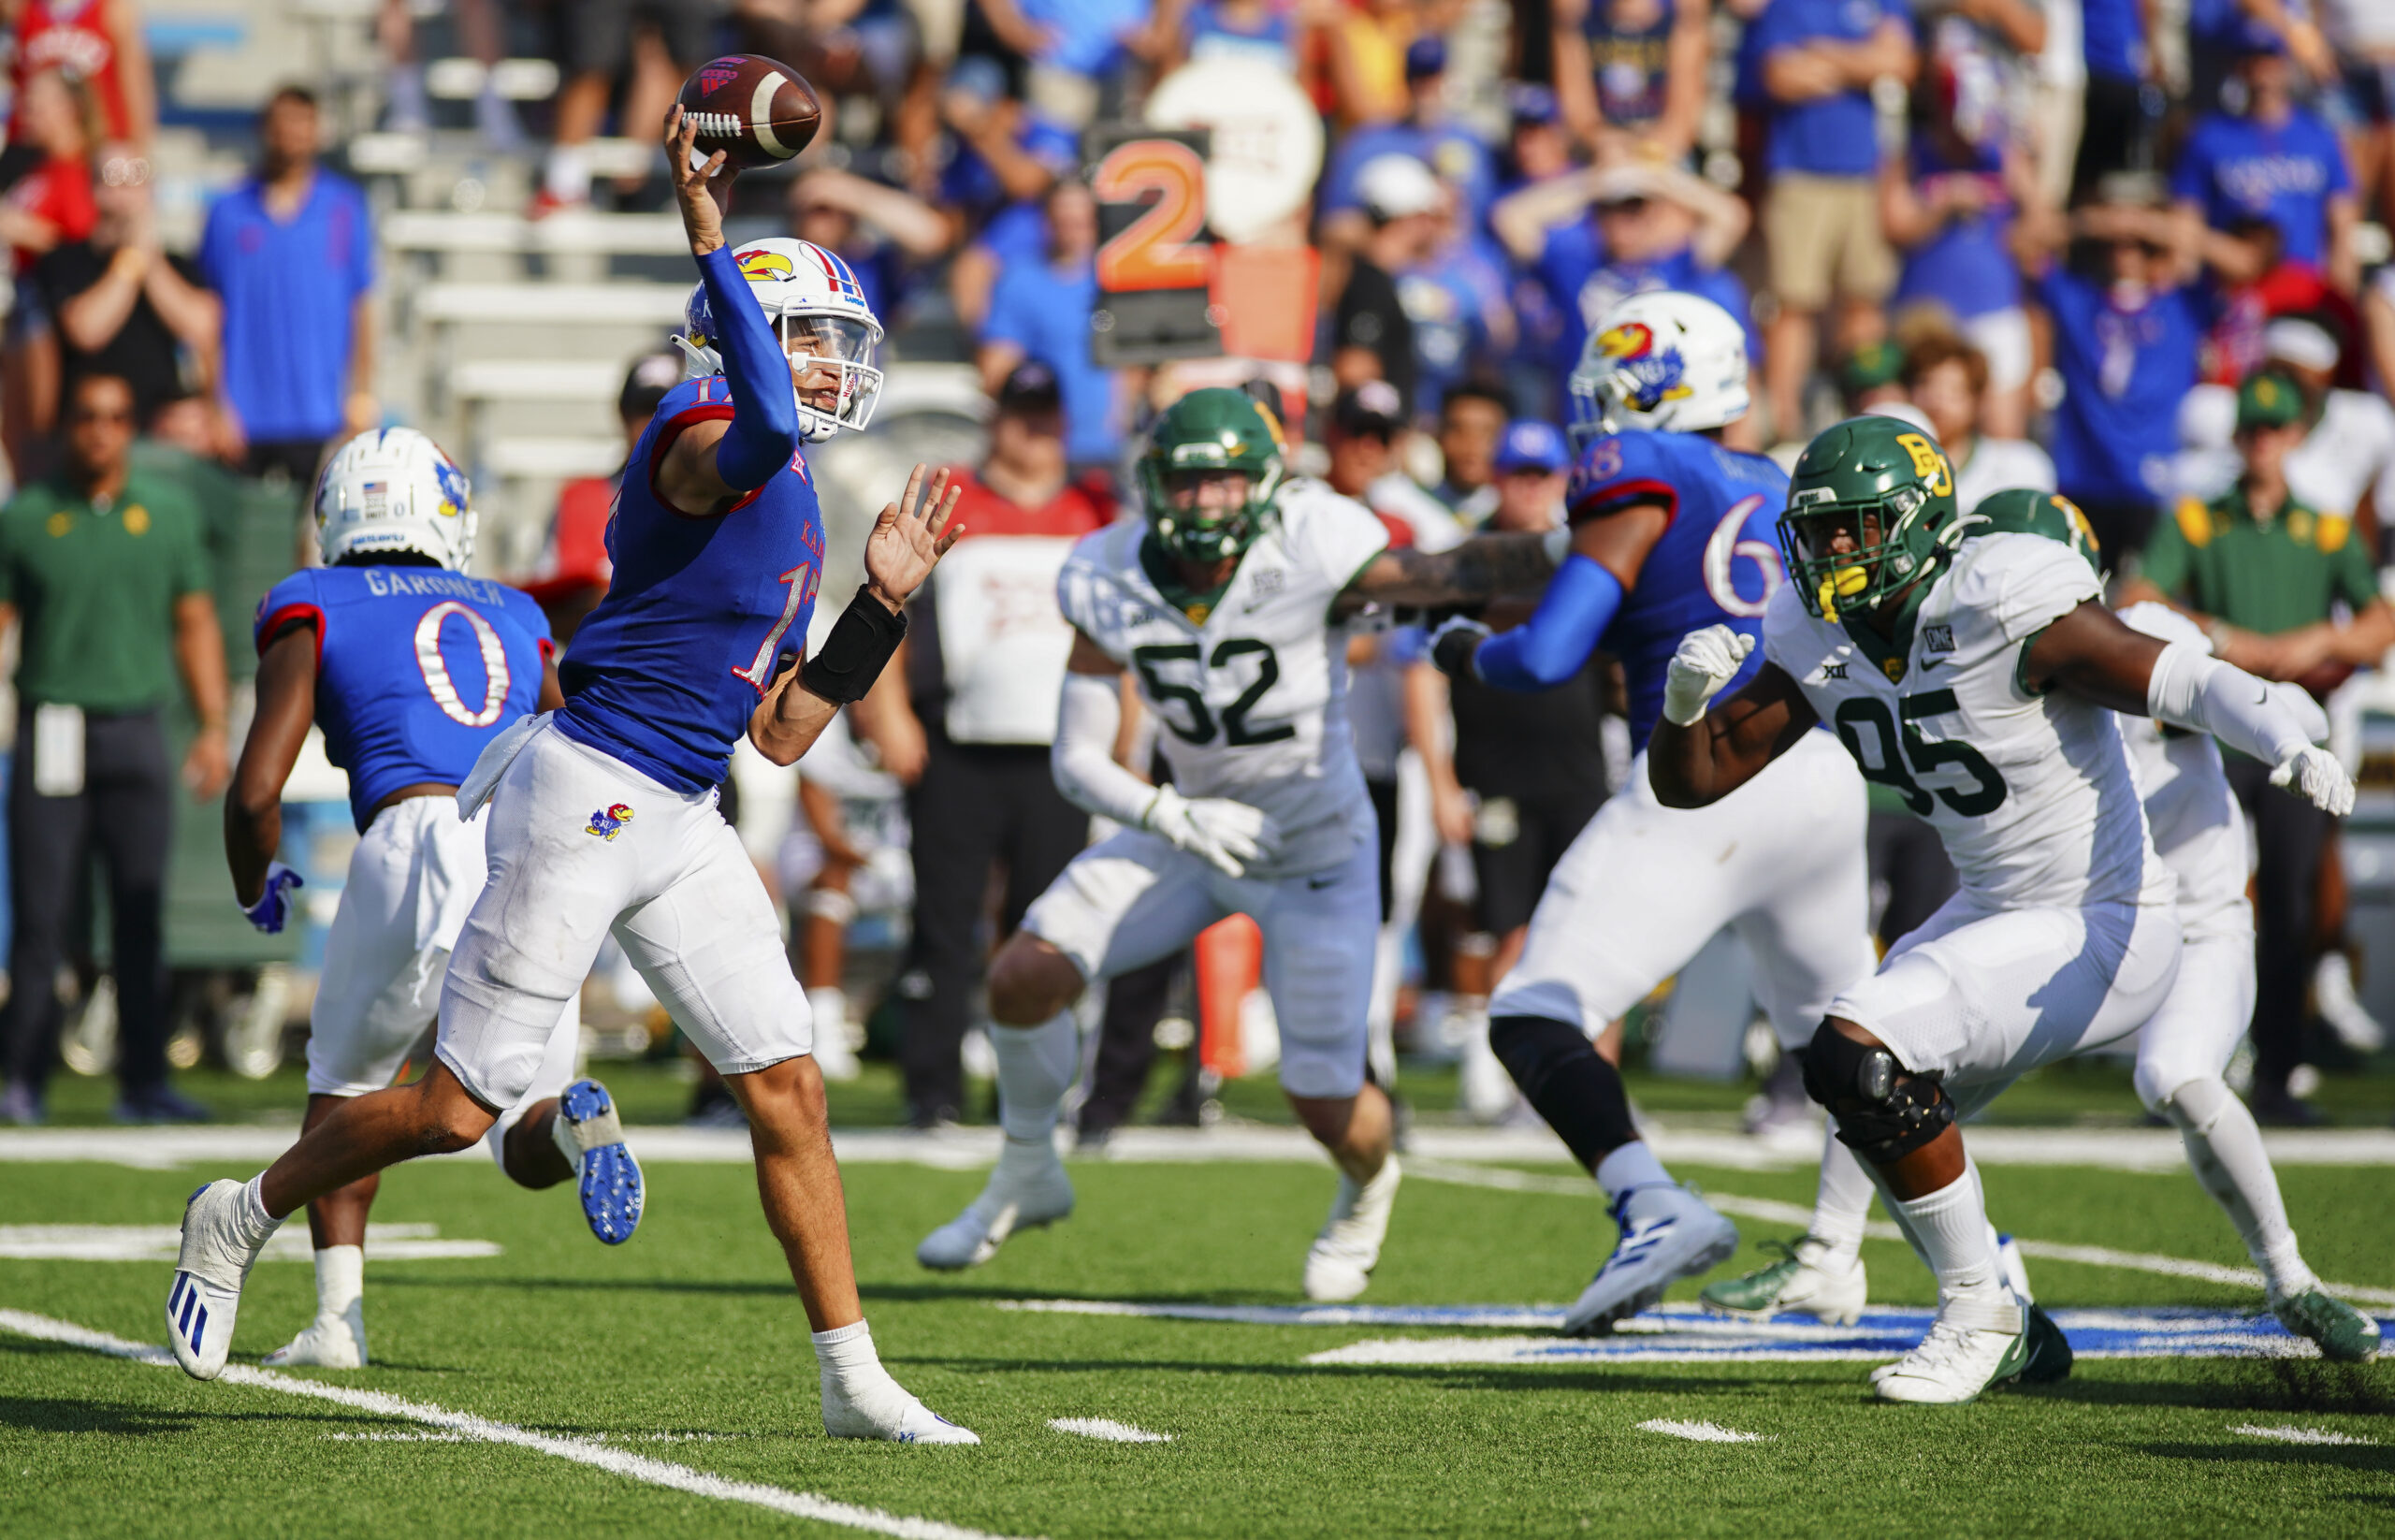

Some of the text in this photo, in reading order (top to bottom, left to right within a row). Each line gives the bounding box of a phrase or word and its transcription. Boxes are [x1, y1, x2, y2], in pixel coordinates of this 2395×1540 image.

[1094, 138, 1211, 293] 2
[364, 569, 505, 608] GARDNER
[1703, 493, 1785, 618] 6
[414, 600, 511, 728] 0
[731, 560, 820, 702] 1
[1134, 639, 1297, 746] 52
[1822, 662, 1850, 680] XII
[1835, 688, 2008, 818] 95
